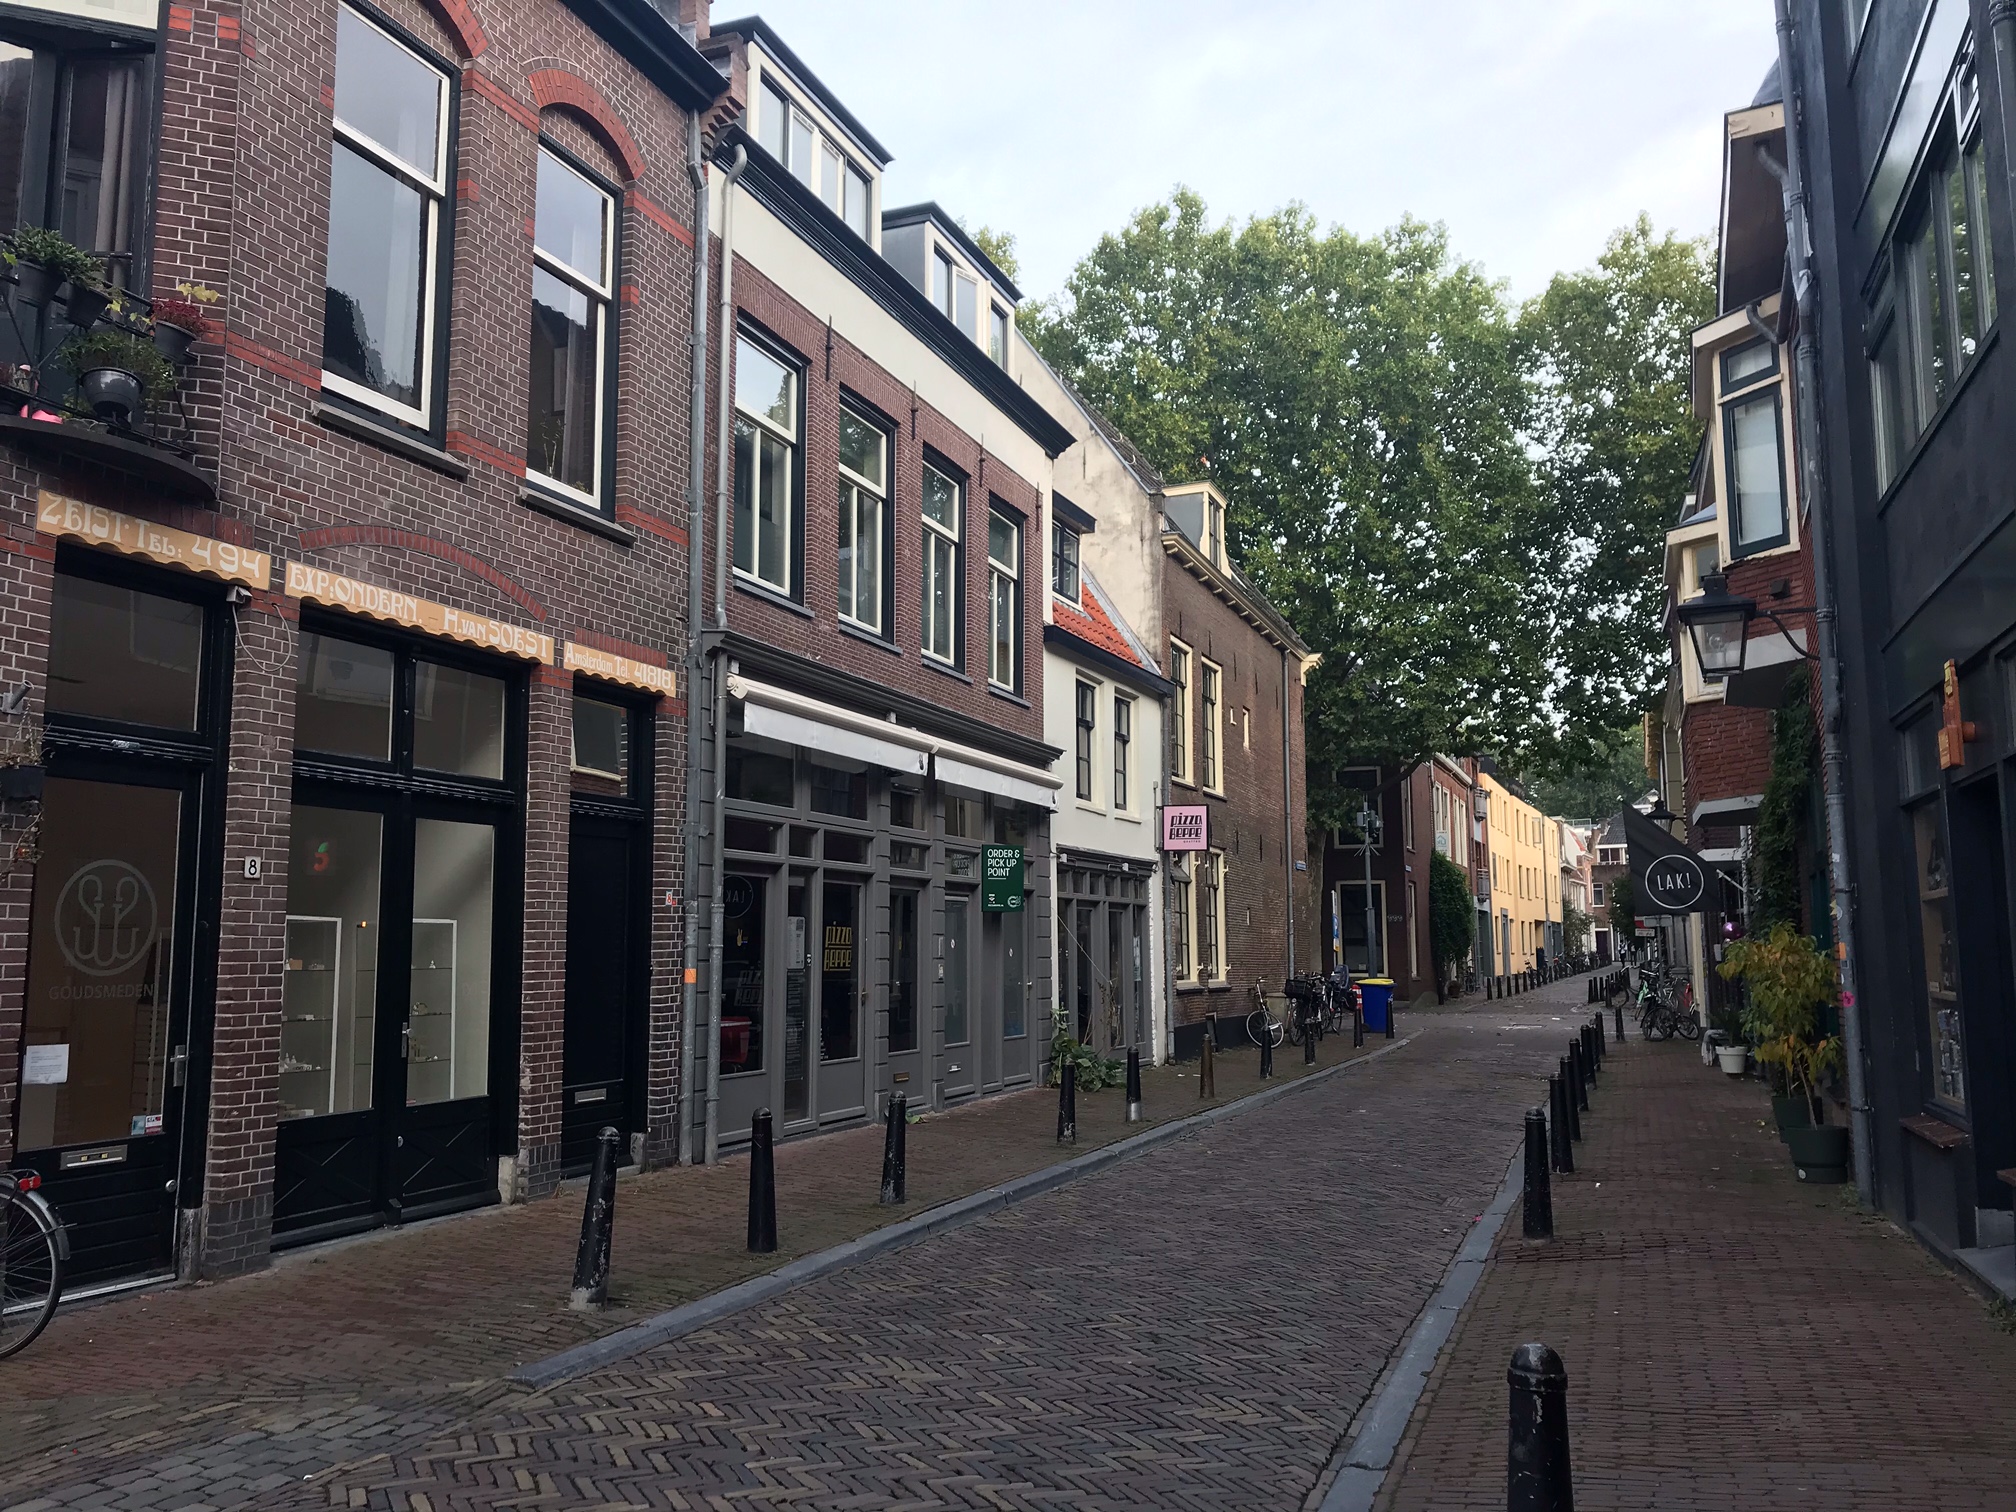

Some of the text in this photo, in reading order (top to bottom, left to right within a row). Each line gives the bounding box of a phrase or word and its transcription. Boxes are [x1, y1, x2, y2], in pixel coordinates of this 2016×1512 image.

[191, 536, 262, 579] 494
[488, 620, 550, 658] SOEST
[987, 848, 1020, 858] ORDER &
[248, 859, 257, 876] 8
[987, 858, 1017, 868] PICK UP
[987, 867, 1011, 877] POINT
[1657, 872, 1691, 891] LAK!
[667, 893, 672, 903] 8
[48, 983, 155, 1001] GOUDSMEDEN
